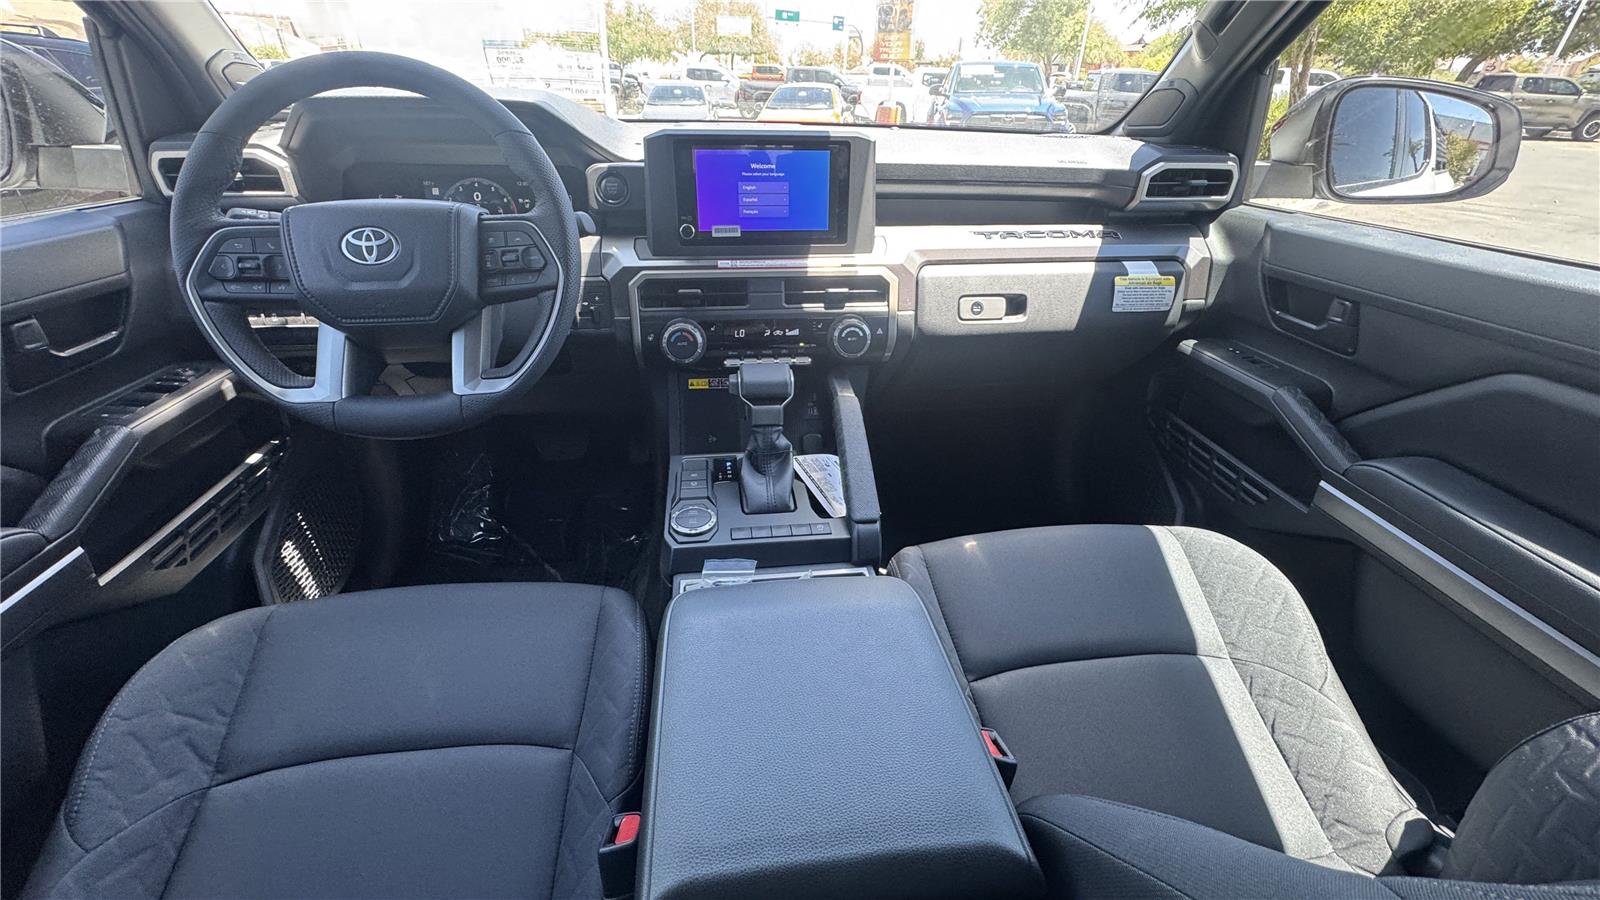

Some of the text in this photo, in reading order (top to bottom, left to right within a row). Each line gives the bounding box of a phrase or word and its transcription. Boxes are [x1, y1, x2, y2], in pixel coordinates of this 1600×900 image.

[473, 191, 482, 202] 0
[972, 230, 1123, 240] TACOMA
[734, 329, 745, 338] LO
